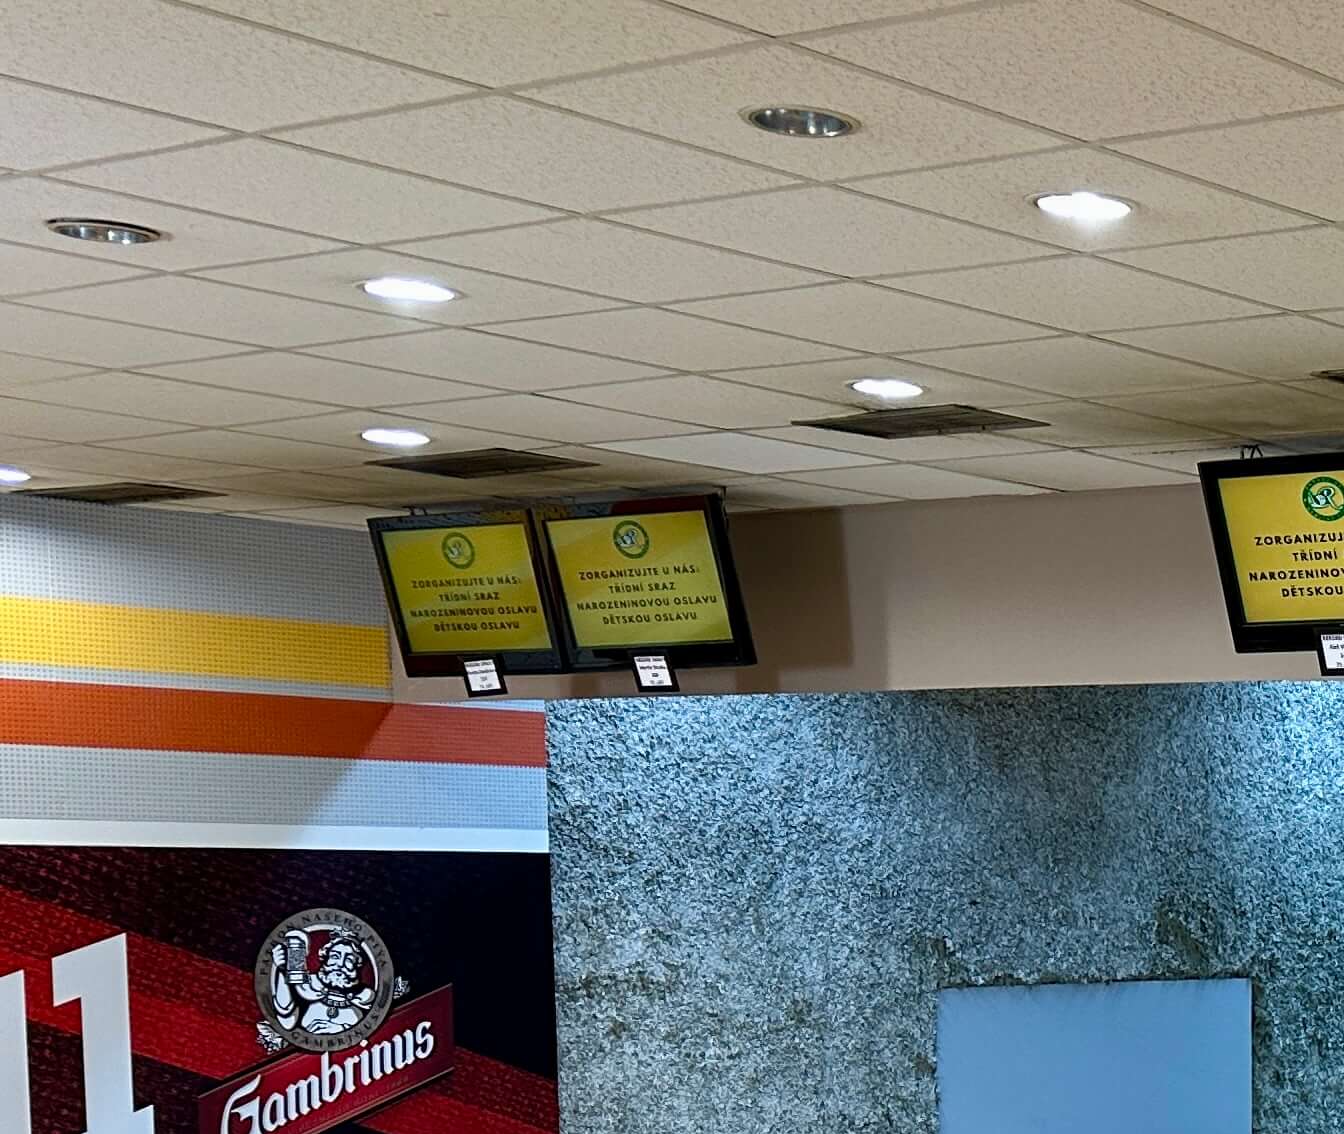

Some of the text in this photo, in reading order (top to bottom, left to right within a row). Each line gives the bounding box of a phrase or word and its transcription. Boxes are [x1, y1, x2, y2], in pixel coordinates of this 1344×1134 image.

[1292, 548, 1338, 562] TŘÍDNÍ
[1281, 583, 1344, 598] DĚTSKOU
[291, 1013, 379, 1047] GAMBRINUS
